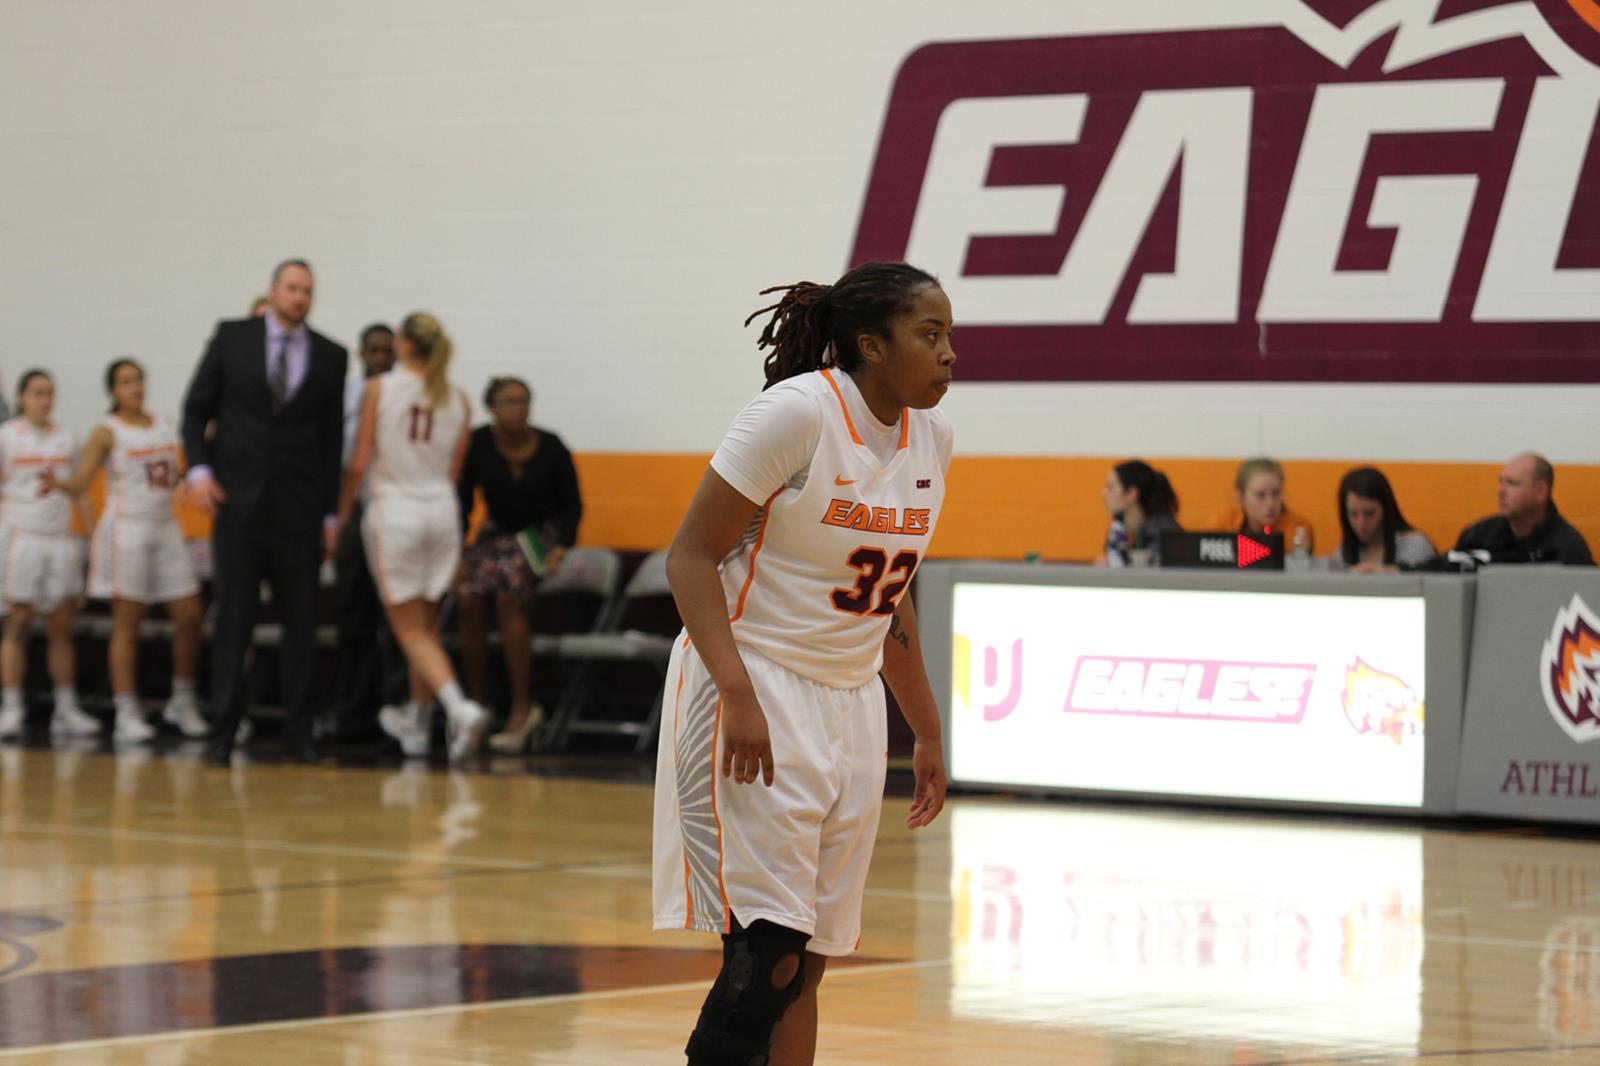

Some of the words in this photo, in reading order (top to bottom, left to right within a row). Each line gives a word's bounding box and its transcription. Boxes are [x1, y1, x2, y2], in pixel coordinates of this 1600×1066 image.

[408, 404, 433, 443] 11
[821, 498, 931, 535] EAGLES
[829, 545, 918, 617] 32
[1070, 659, 1306, 718] EAGLES
[1500, 759, 1600, 799] ATHL
